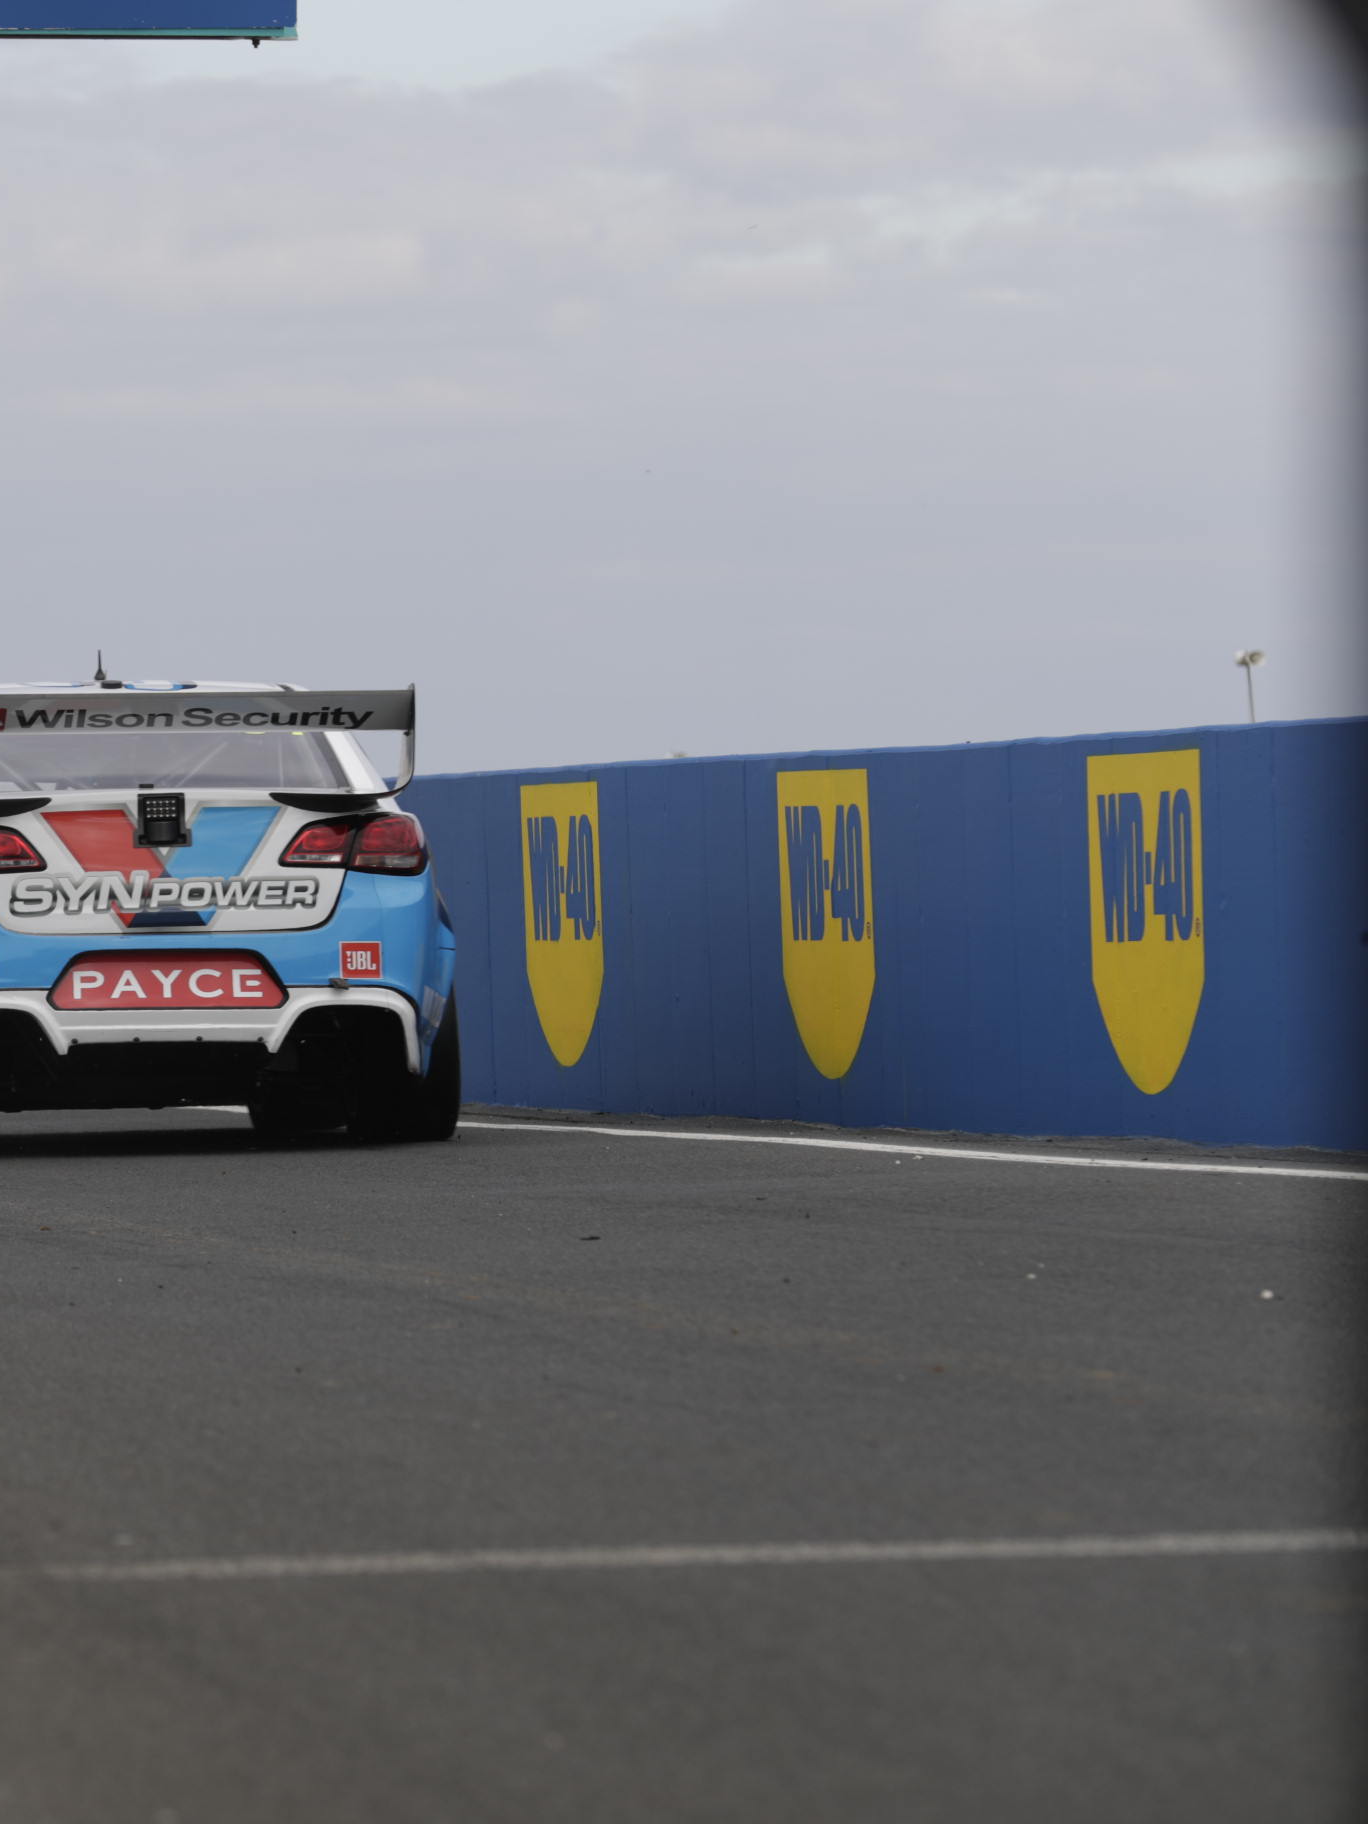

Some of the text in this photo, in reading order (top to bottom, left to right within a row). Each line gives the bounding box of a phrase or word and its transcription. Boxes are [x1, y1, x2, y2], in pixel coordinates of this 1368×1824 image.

[15, 706, 375, 730] Wilson Security
[527, 814, 596, 942] WD-40
[785, 804, 865, 942] WD-40
[1097, 788, 1194, 943] WD-40
[72, 968, 264, 1000] PAYCE
[345, 950, 377, 971] JBL
